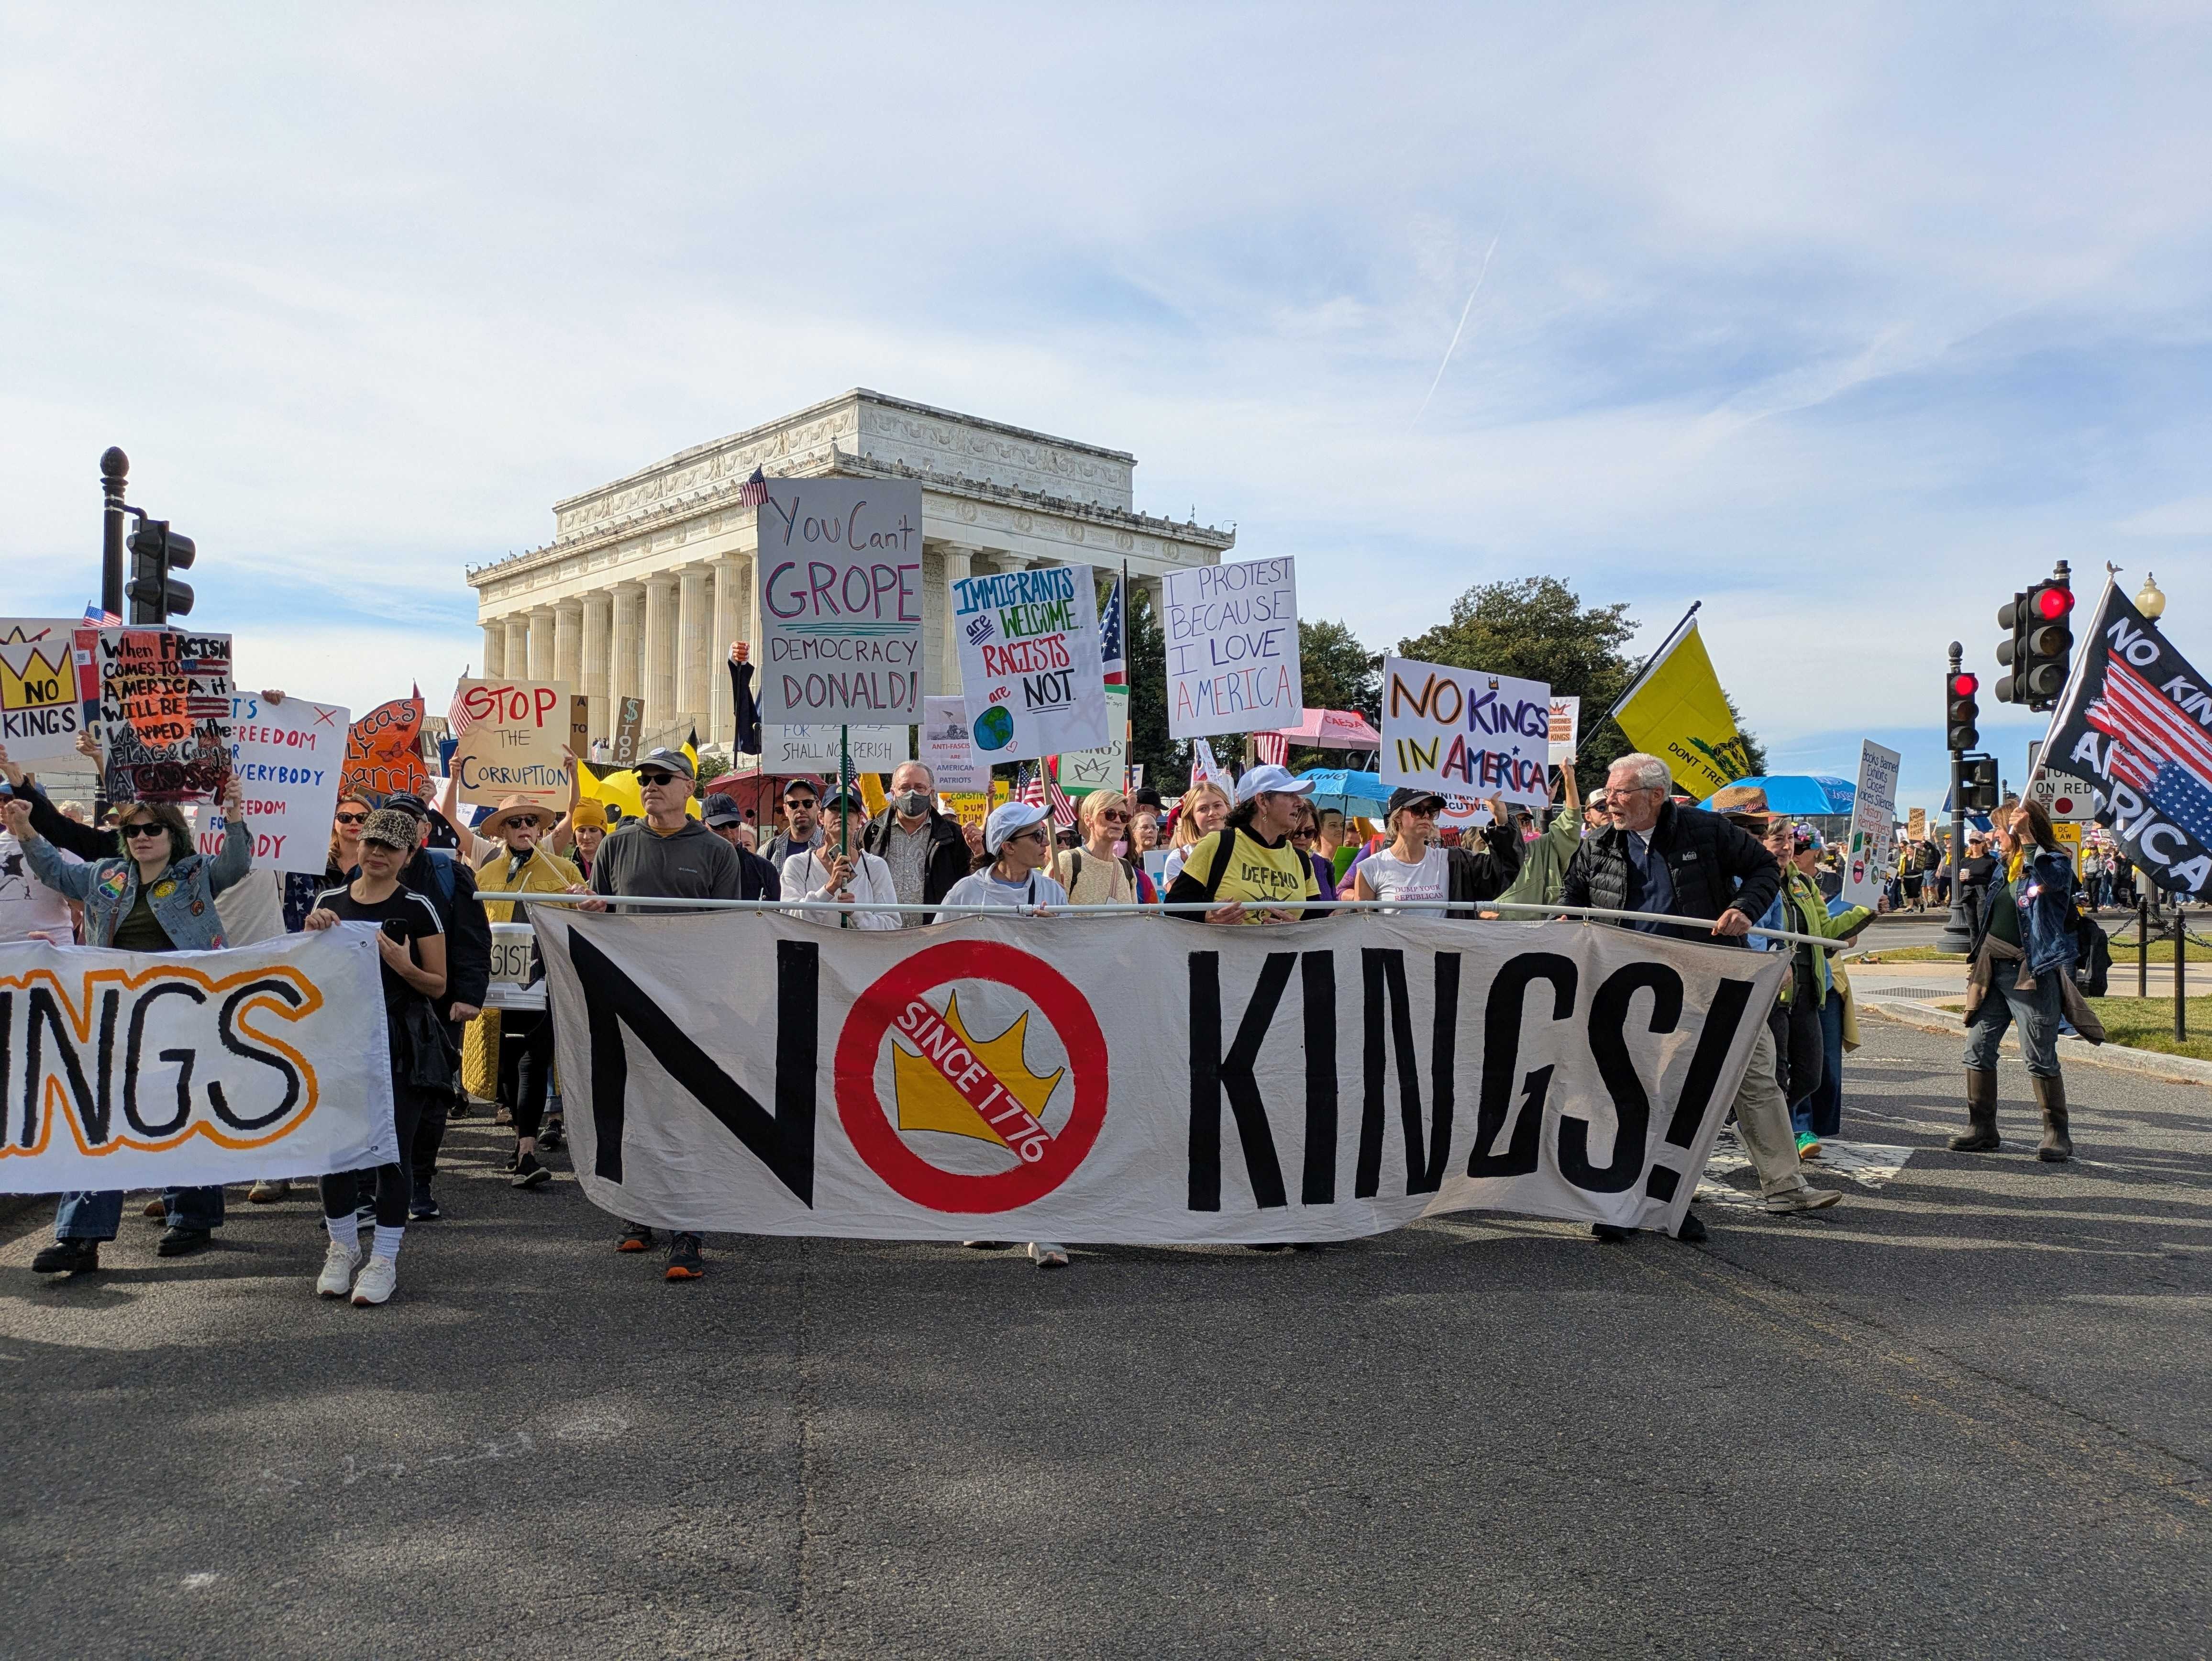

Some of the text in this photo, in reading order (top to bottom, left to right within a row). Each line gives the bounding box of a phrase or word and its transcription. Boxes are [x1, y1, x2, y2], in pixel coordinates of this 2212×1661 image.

[794, 451, 816, 462] COLORAO
[848, 501, 916, 552] Can't
[1141, 541, 1156, 549] OHIO
[765, 562, 921, 621] GROPE
[952, 567, 1074, 616] IMMIGRANTS
[1163, 557, 1294, 609] I PROTEST
[966, 615, 991, 637] are
[1172, 590, 1291, 640] BECAUSE
[771, 637, 918, 665] DEMOCRACY
[1170, 628, 1286, 676] I LOVE
[2106, 616, 2161, 666] NO
[982, 633, 1070, 678] RACISTS
[103, 660, 179, 679] COMES TO
[24, 678, 59, 704] NO
[103, 676, 227, 703] AMERICA it
[783, 671, 918, 713] DONALD!
[988, 686, 1011, 703] are
[1177, 664, 1293, 722] AMERICA
[1390, 672, 1463, 725] NO
[100, 698, 183, 722] WILL BE
[232, 698, 258, 719] T'S
[465, 686, 557, 728] STOP
[2, 707, 77, 739] KINGS
[106, 722, 185, 743] WRAPPED
[784, 724, 811, 738] FOR
[346, 742, 375, 760] LY
[494, 730, 531, 748] THE
[781, 742, 892, 761] SHALL NO PERISH
[109, 743, 166, 766] FLAG
[1395, 735, 1439, 774] IN
[1668, 741, 1728, 789] DONT TRE
[233, 764, 325, 786] VERYBODY
[460, 755, 569, 789] CORRUPTION
[2036, 782, 2092, 794] ON RED
[220, 799, 286, 816] EEDOM
[956, 813, 983, 823] TRUM
[964, 804, 986, 812] DUM
[1444, 802, 1489, 811] CUTIVE
[2070, 731, 2212, 892] ARICA
[210, 816, 224, 830] FO
[199, 833, 288, 859] NODY
[1242, 862, 1299, 890] DEFEND
[1394, 884, 1440, 894] DUMP YOUR
[1394, 892, 1444, 902] REPUBLICAN
[490, 944, 531, 976] SIST
[0, 979, 302, 1148] INGS
[896, 1001, 1048, 1163] SINCE 1776
[1188, 947, 1756, 1212] KINGS!
